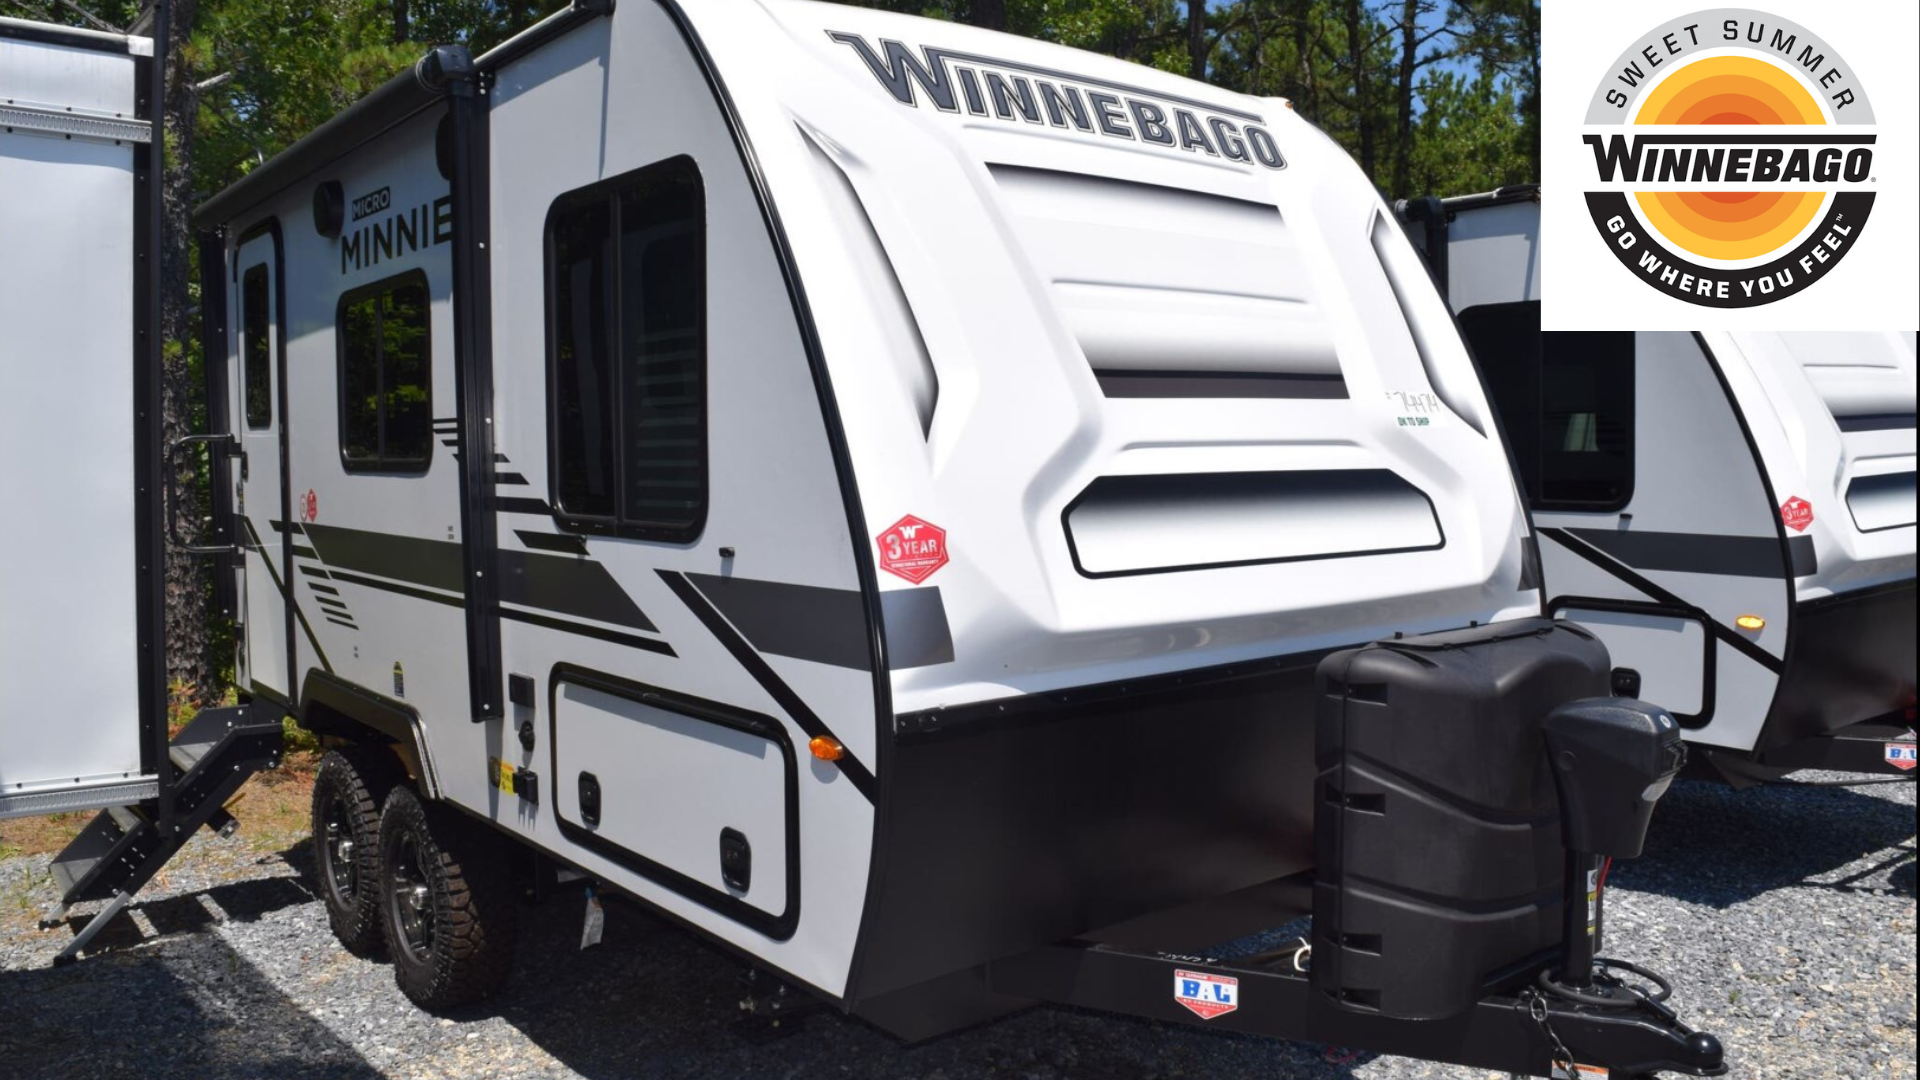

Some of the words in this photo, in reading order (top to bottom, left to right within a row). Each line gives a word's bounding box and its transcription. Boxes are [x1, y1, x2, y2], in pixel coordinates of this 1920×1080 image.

[824, 29, 1288, 170] WINNEBAGO
[352, 188, 389, 219] MICRO
[342, 195, 452, 274] MINNIE
[886, 534, 902, 560] 3
[902, 539, 937, 555] YEAR
